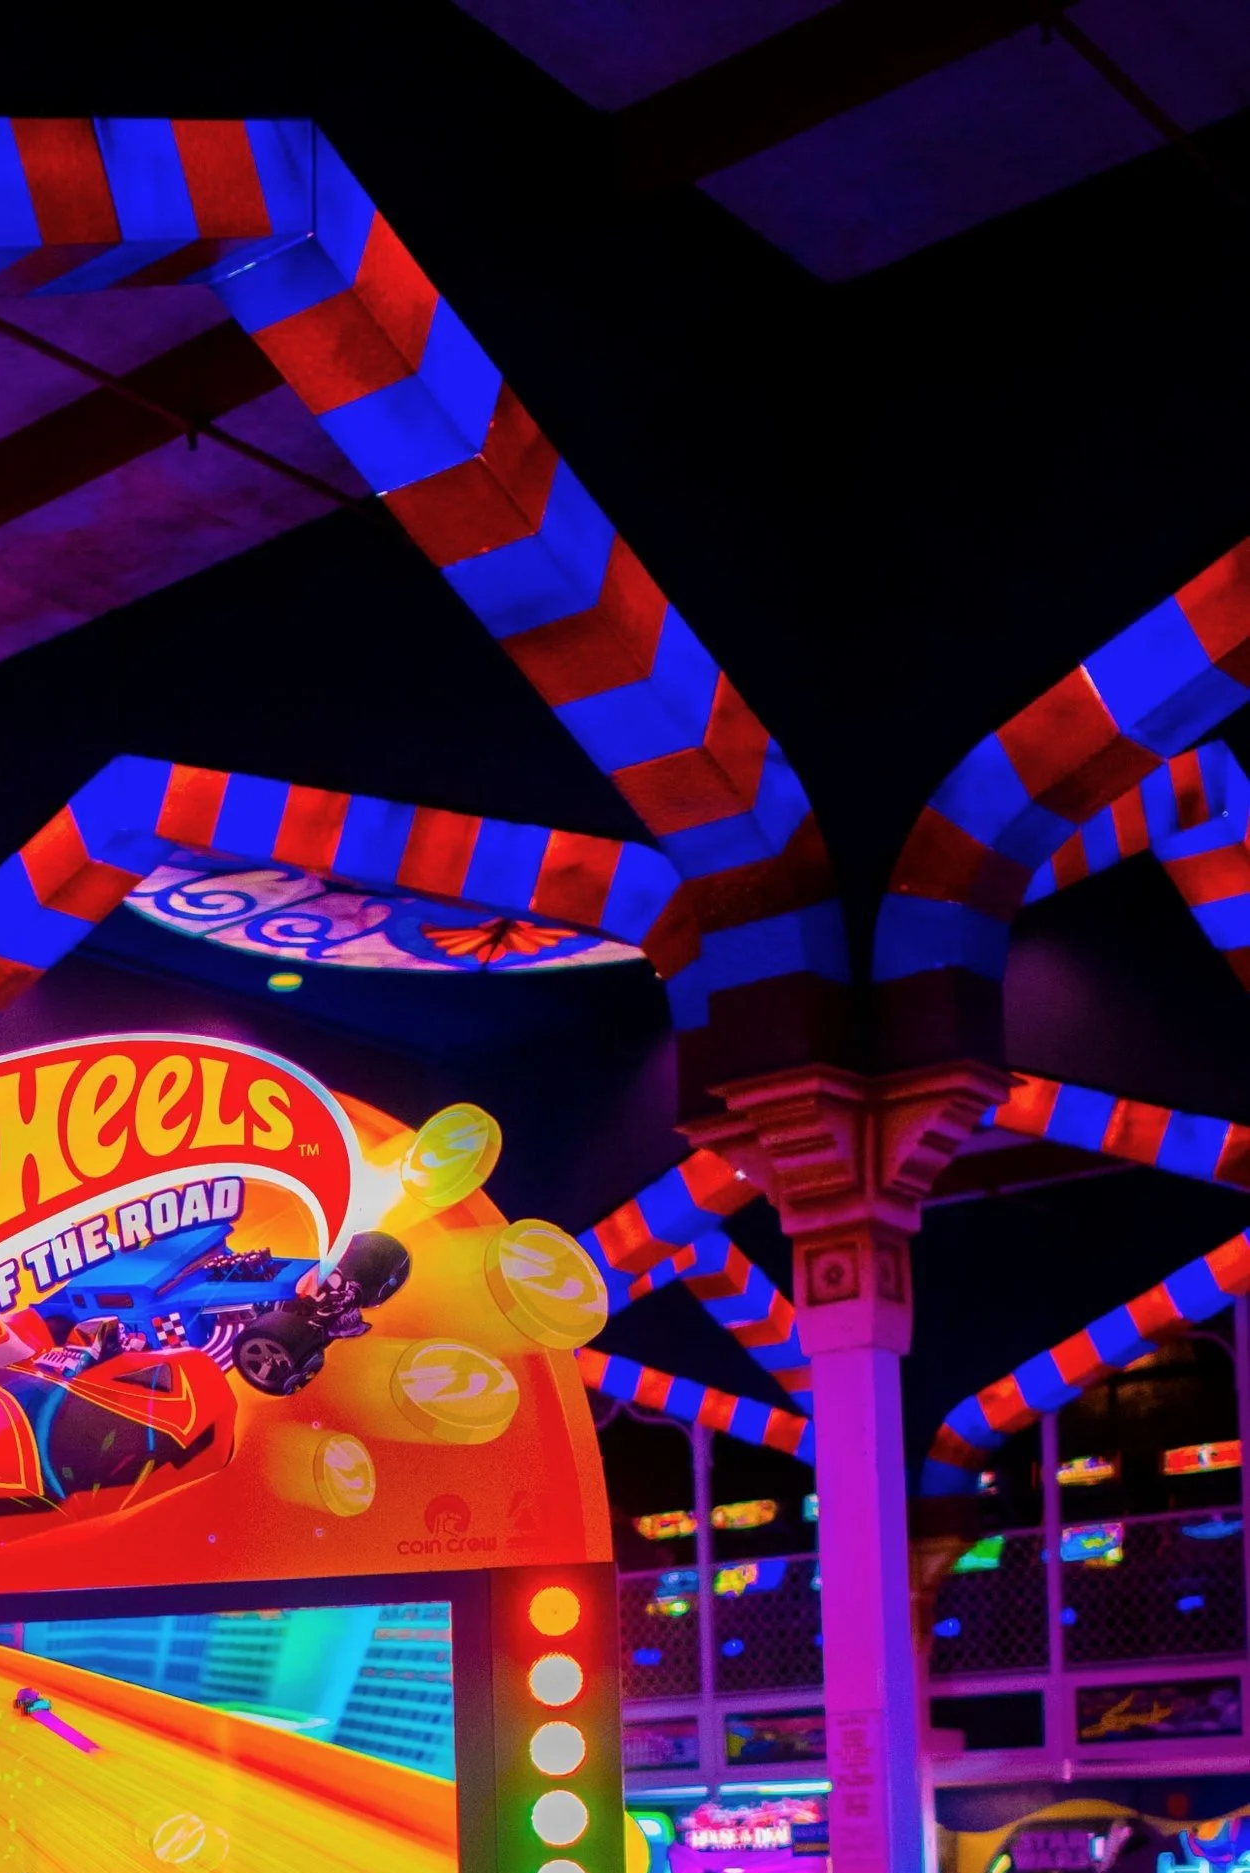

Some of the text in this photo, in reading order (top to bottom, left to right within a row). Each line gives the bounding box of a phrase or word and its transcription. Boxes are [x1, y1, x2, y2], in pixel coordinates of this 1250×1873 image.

[25, 1221, 109, 1296] THE
[117, 1178, 241, 1249] ROAD
[397, 1538, 442, 1555] coin
